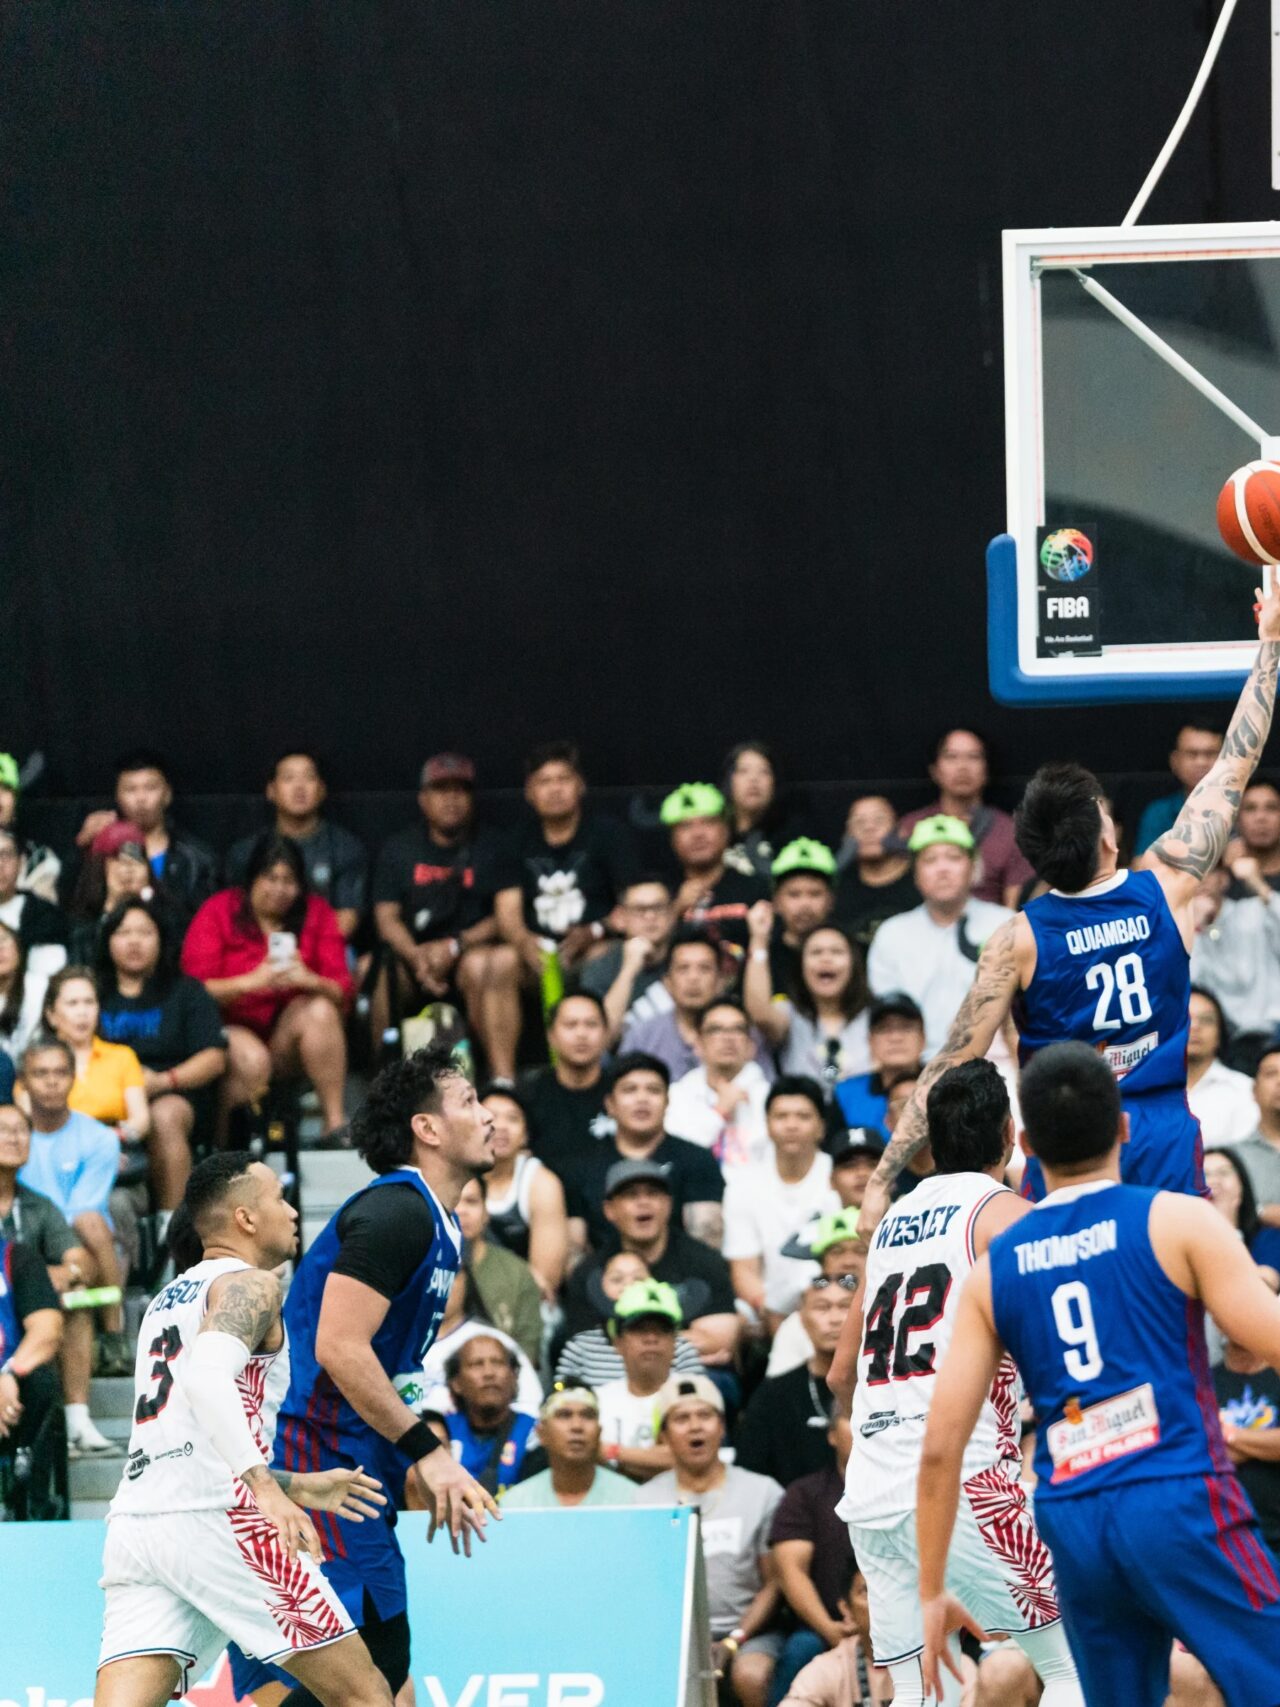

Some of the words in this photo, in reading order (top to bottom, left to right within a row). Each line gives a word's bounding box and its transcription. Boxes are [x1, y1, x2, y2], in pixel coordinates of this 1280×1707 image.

[1047, 596, 1089, 619] FIBA
[1065, 915, 1151, 955] QUIAMBAO
[1085, 952, 1152, 1031] 28
[875, 1204, 961, 1250] WESLEY
[1014, 1219, 1117, 1275] THOMPSON
[863, 1262, 953, 1387] 42
[1050, 1280, 1104, 1382] 9
[135, 1324, 184, 1426] 3
